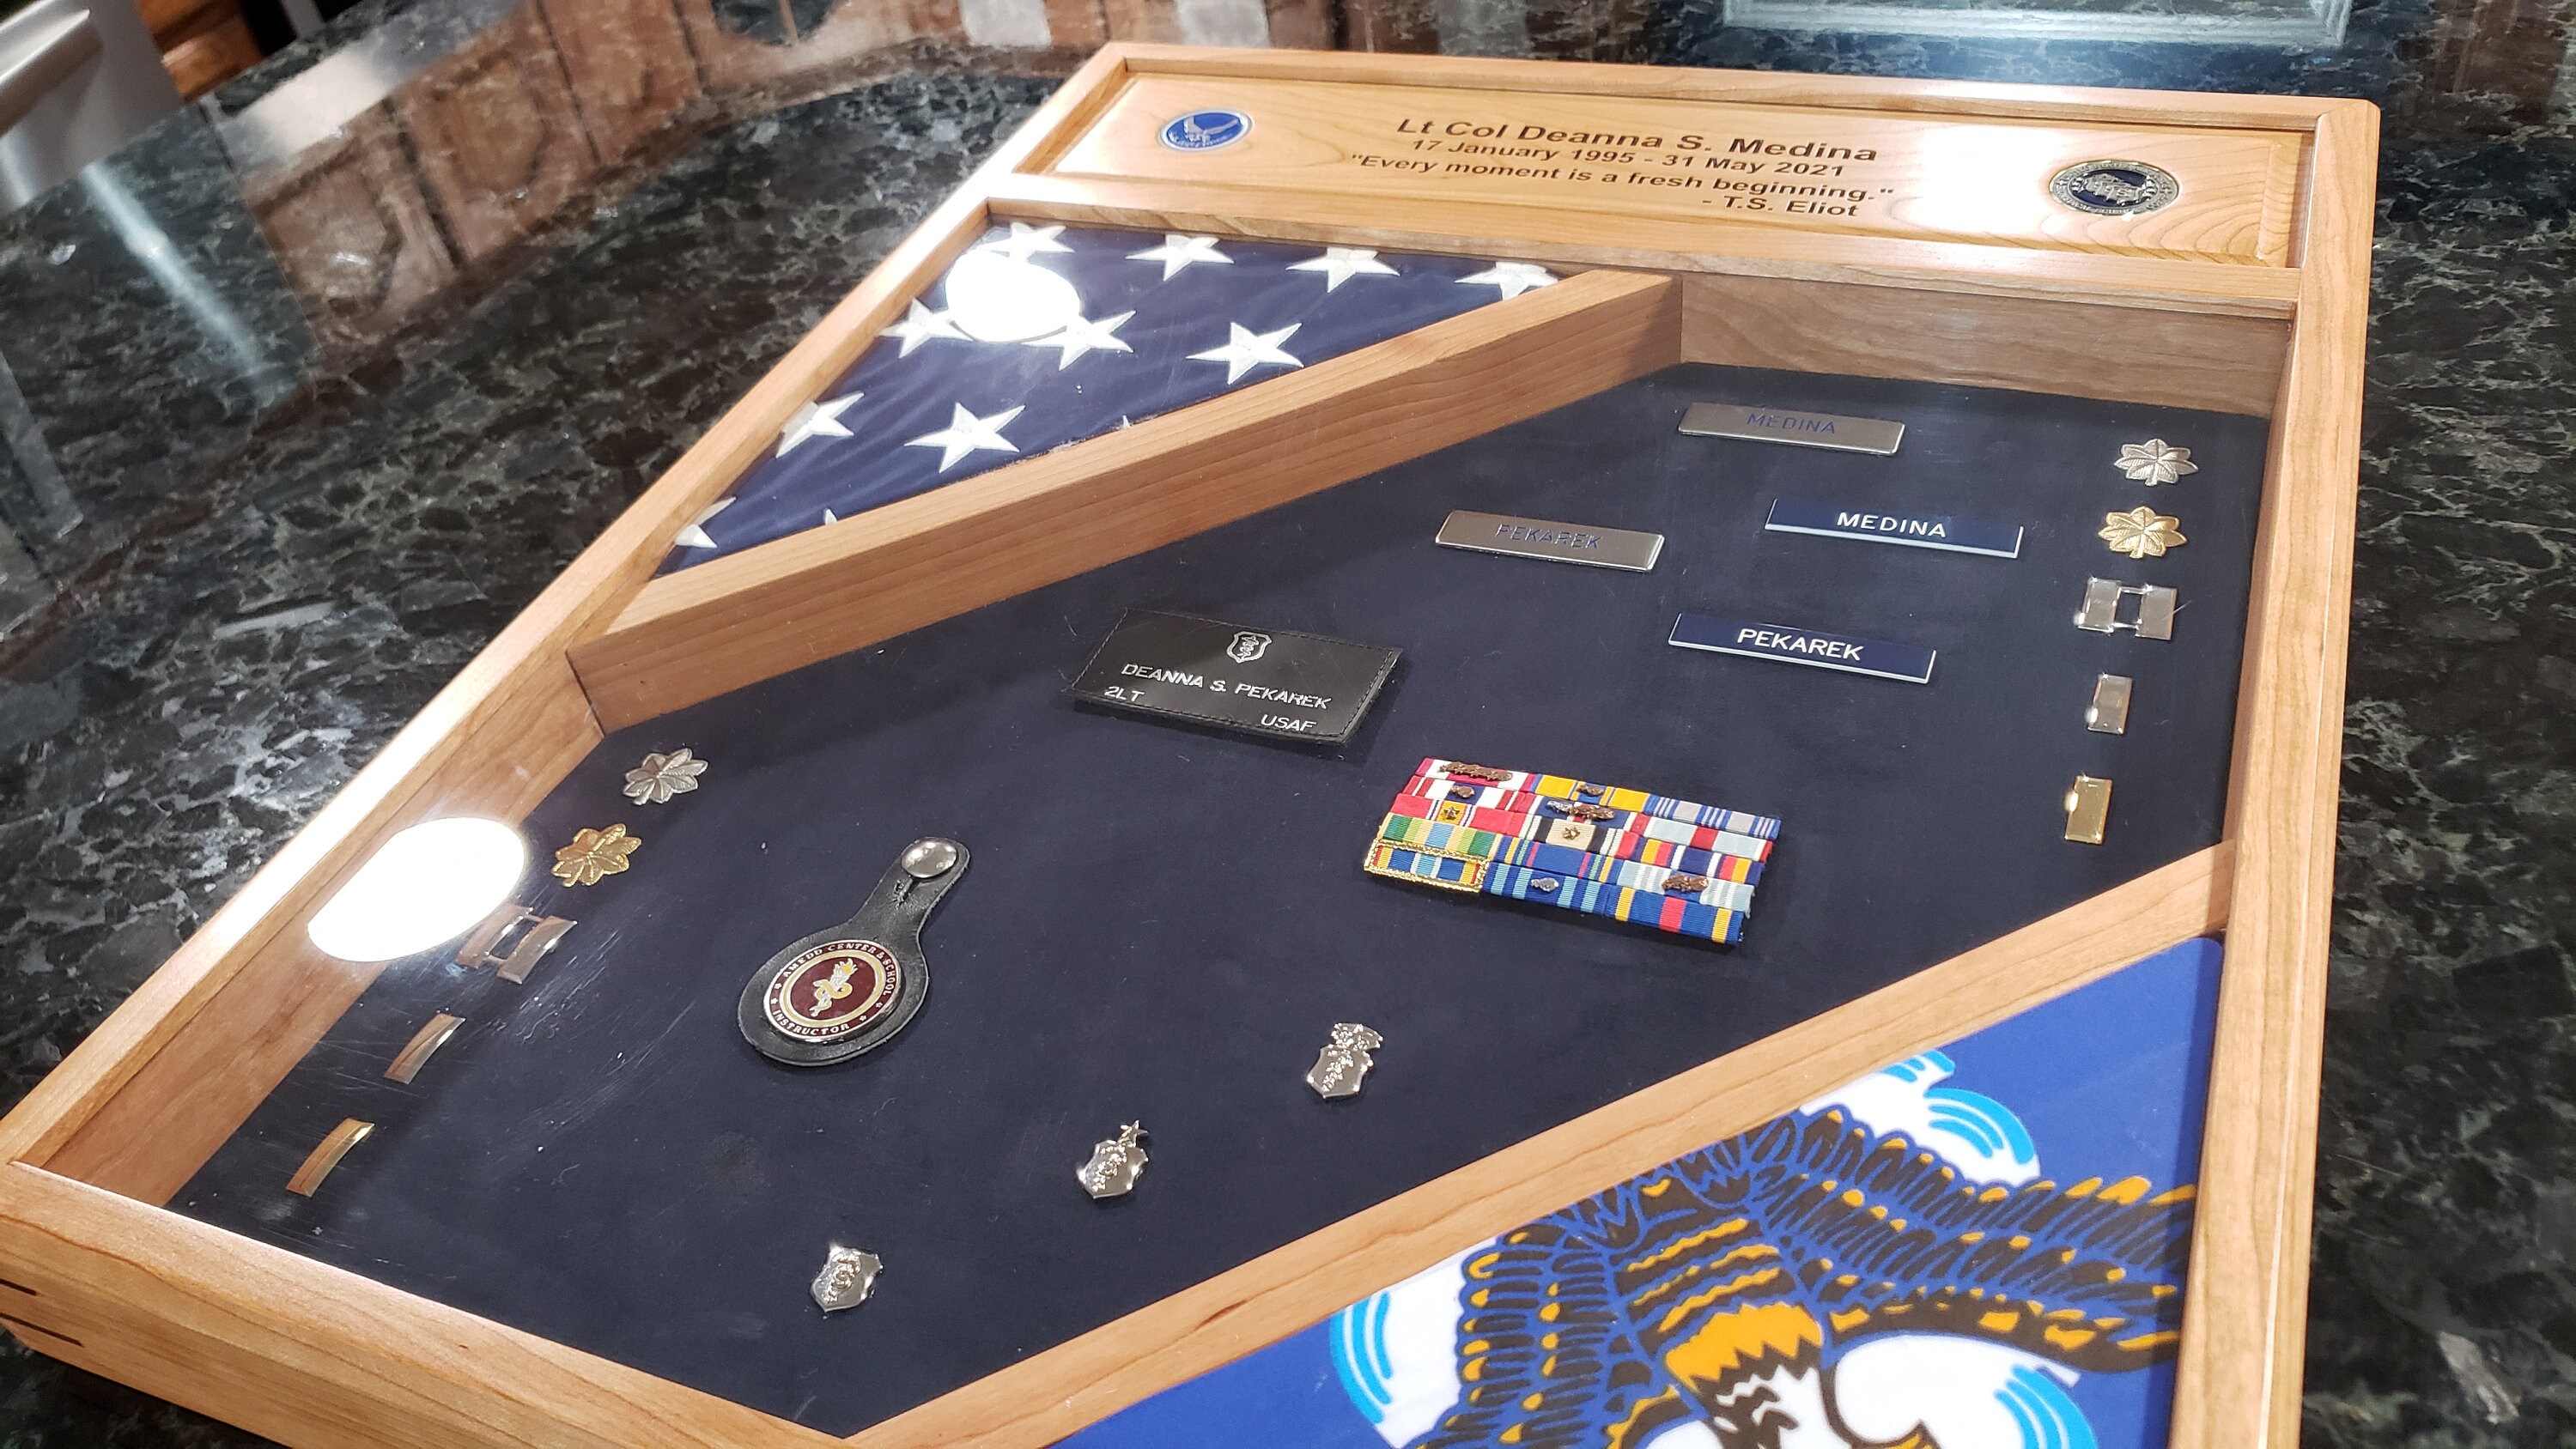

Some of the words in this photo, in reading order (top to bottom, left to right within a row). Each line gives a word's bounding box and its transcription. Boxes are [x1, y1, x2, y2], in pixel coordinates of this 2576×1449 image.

[1396, 118, 1434, 134] Lt
[1445, 121, 1508, 138] Col
[1517, 125, 1662, 149] Deanna
[1677, 135, 1711, 152] S.
[1728, 138, 1877, 161] Medina
[1413, 140, 1442, 151] 17
[1448, 142, 1560, 161] January
[1571, 149, 1636, 164] 1995
[1662, 155, 1693, 167] 31
[1705, 158, 1766, 174] May
[1773, 162, 1844, 177] 2021
[1352, 155, 1438, 173] "Every
[1445, 162, 1561, 179] moment
[1567, 168, 1592, 181] is
[1601, 173, 1618, 183] a
[1627, 173, 1703, 188] fresh
[1712, 179, 1894, 202] beginning."
[1723, 196, 1773, 211] T.S.
[1785, 201, 1861, 216] Eliot
[1747, 413, 1835, 434] MEDINA
[1495, 524, 1602, 549] PEKAREK
[1837, 511, 1947, 539] MEDINA
[1737, 627, 1863, 663] PEKAREK
[1104, 686, 1146, 702] 2LT
[1121, 663, 1204, 688] DEANNA
[1210, 680, 1228, 693] S.
[1234, 682, 1332, 711] PEKAREK
[1261, 714, 1316, 732] USAF
[783, 949, 823, 978] AMEDD
[828, 943, 876, 955] CENTER
[876, 951, 884, 960] &
[883, 957, 896, 996] SCHOOL
[773, 1009, 850, 1035] INSTRUCTOR
